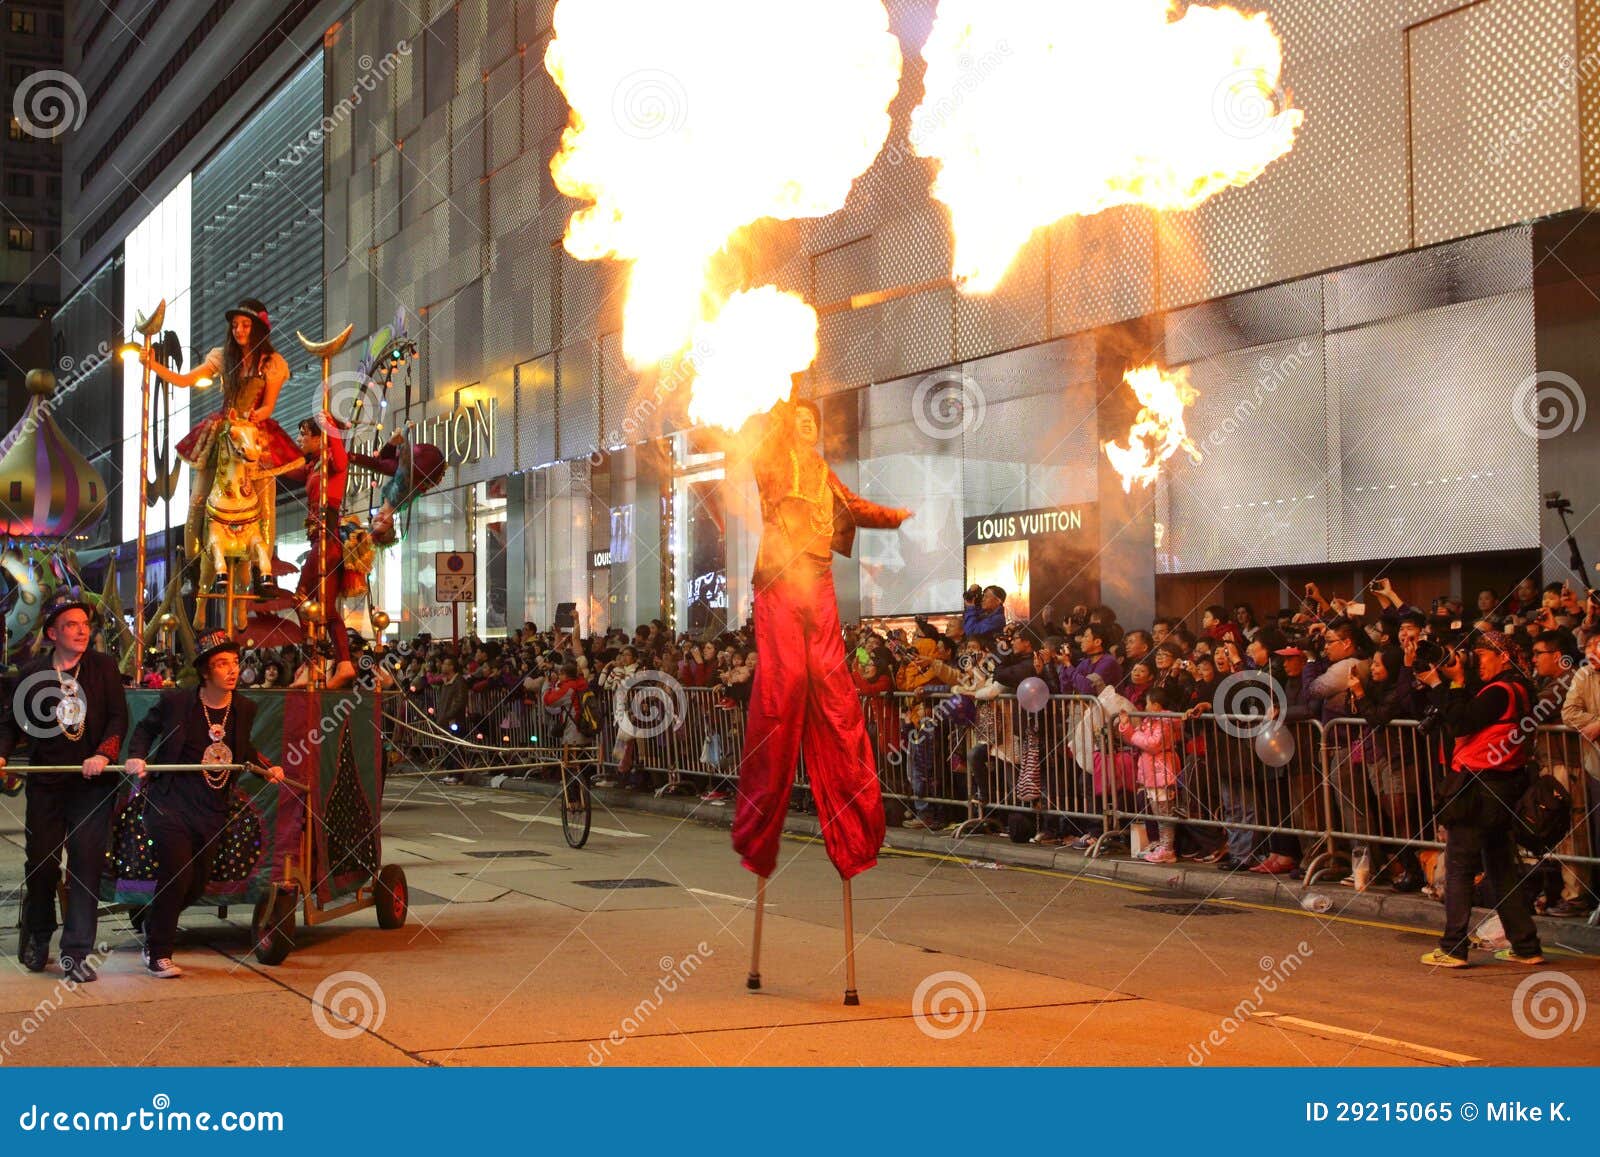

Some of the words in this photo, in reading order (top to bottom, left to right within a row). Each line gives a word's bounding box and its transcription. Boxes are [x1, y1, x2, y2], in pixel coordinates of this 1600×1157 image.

[977, 517, 1016, 540] LOUIS
[1020, 510, 1081, 535] VUITTON
[461, 591, 472, 600] 12
